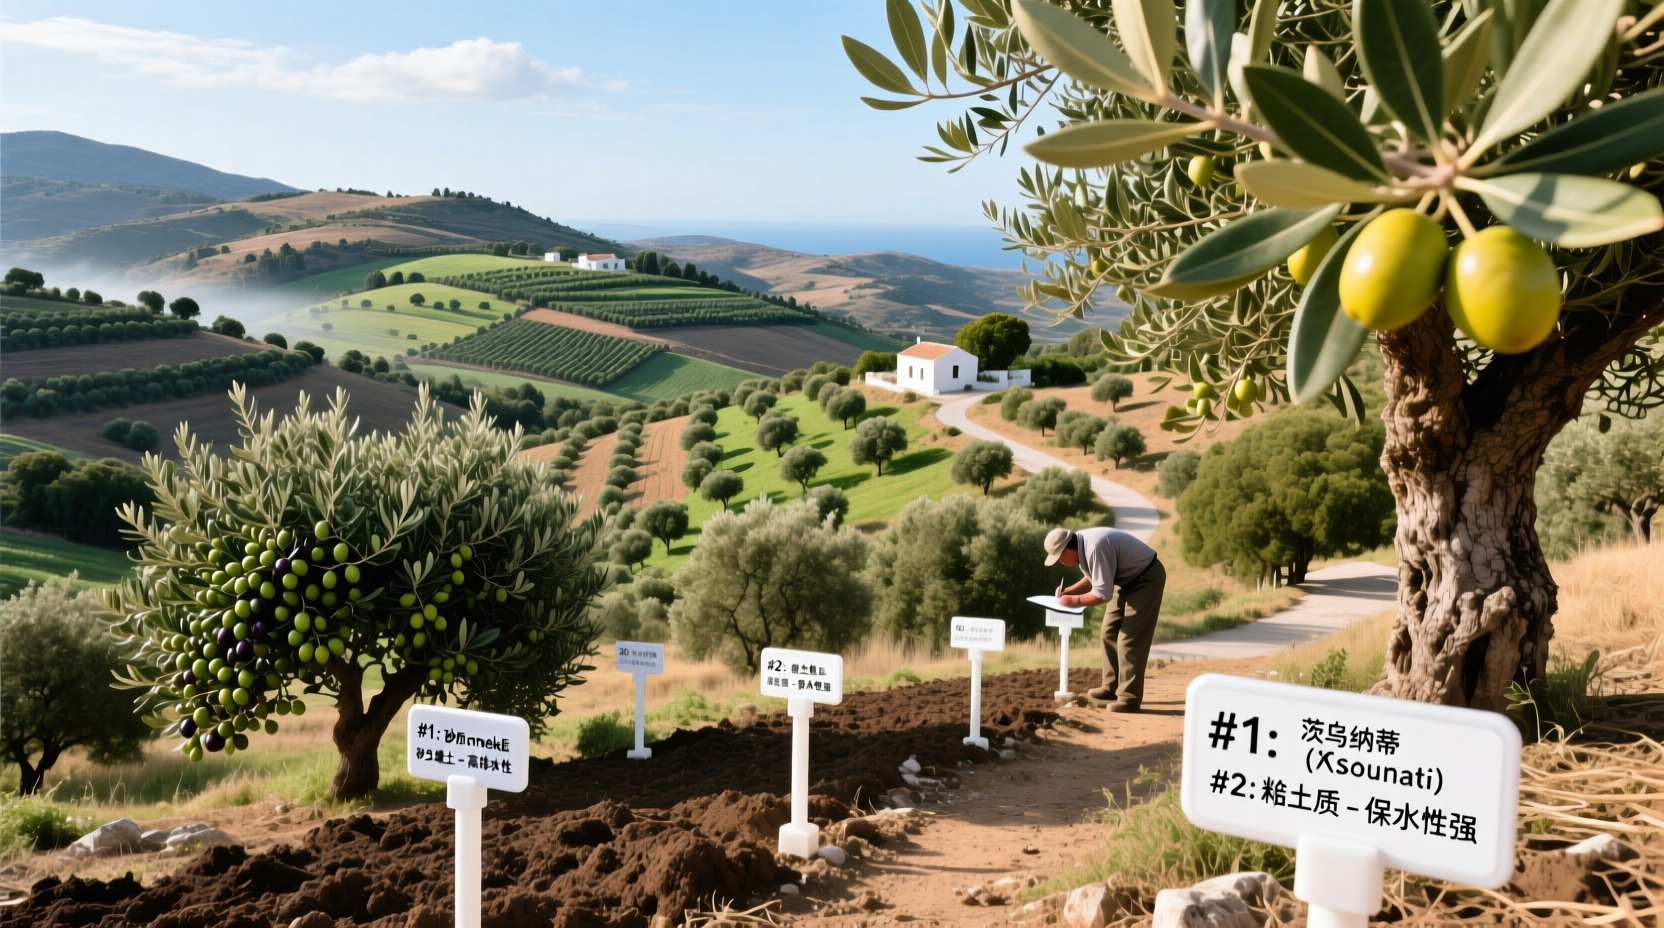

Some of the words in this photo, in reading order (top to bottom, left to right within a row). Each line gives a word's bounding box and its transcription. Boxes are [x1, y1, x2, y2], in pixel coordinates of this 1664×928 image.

[417, 722, 440, 740] #1:
[1208, 711, 1278, 758] #1:
[1301, 717, 1401, 756] 茨乌纳蒂
[1209, 768, 1256, 800] #2:
[1364, 796, 1478, 845] 保水性强
